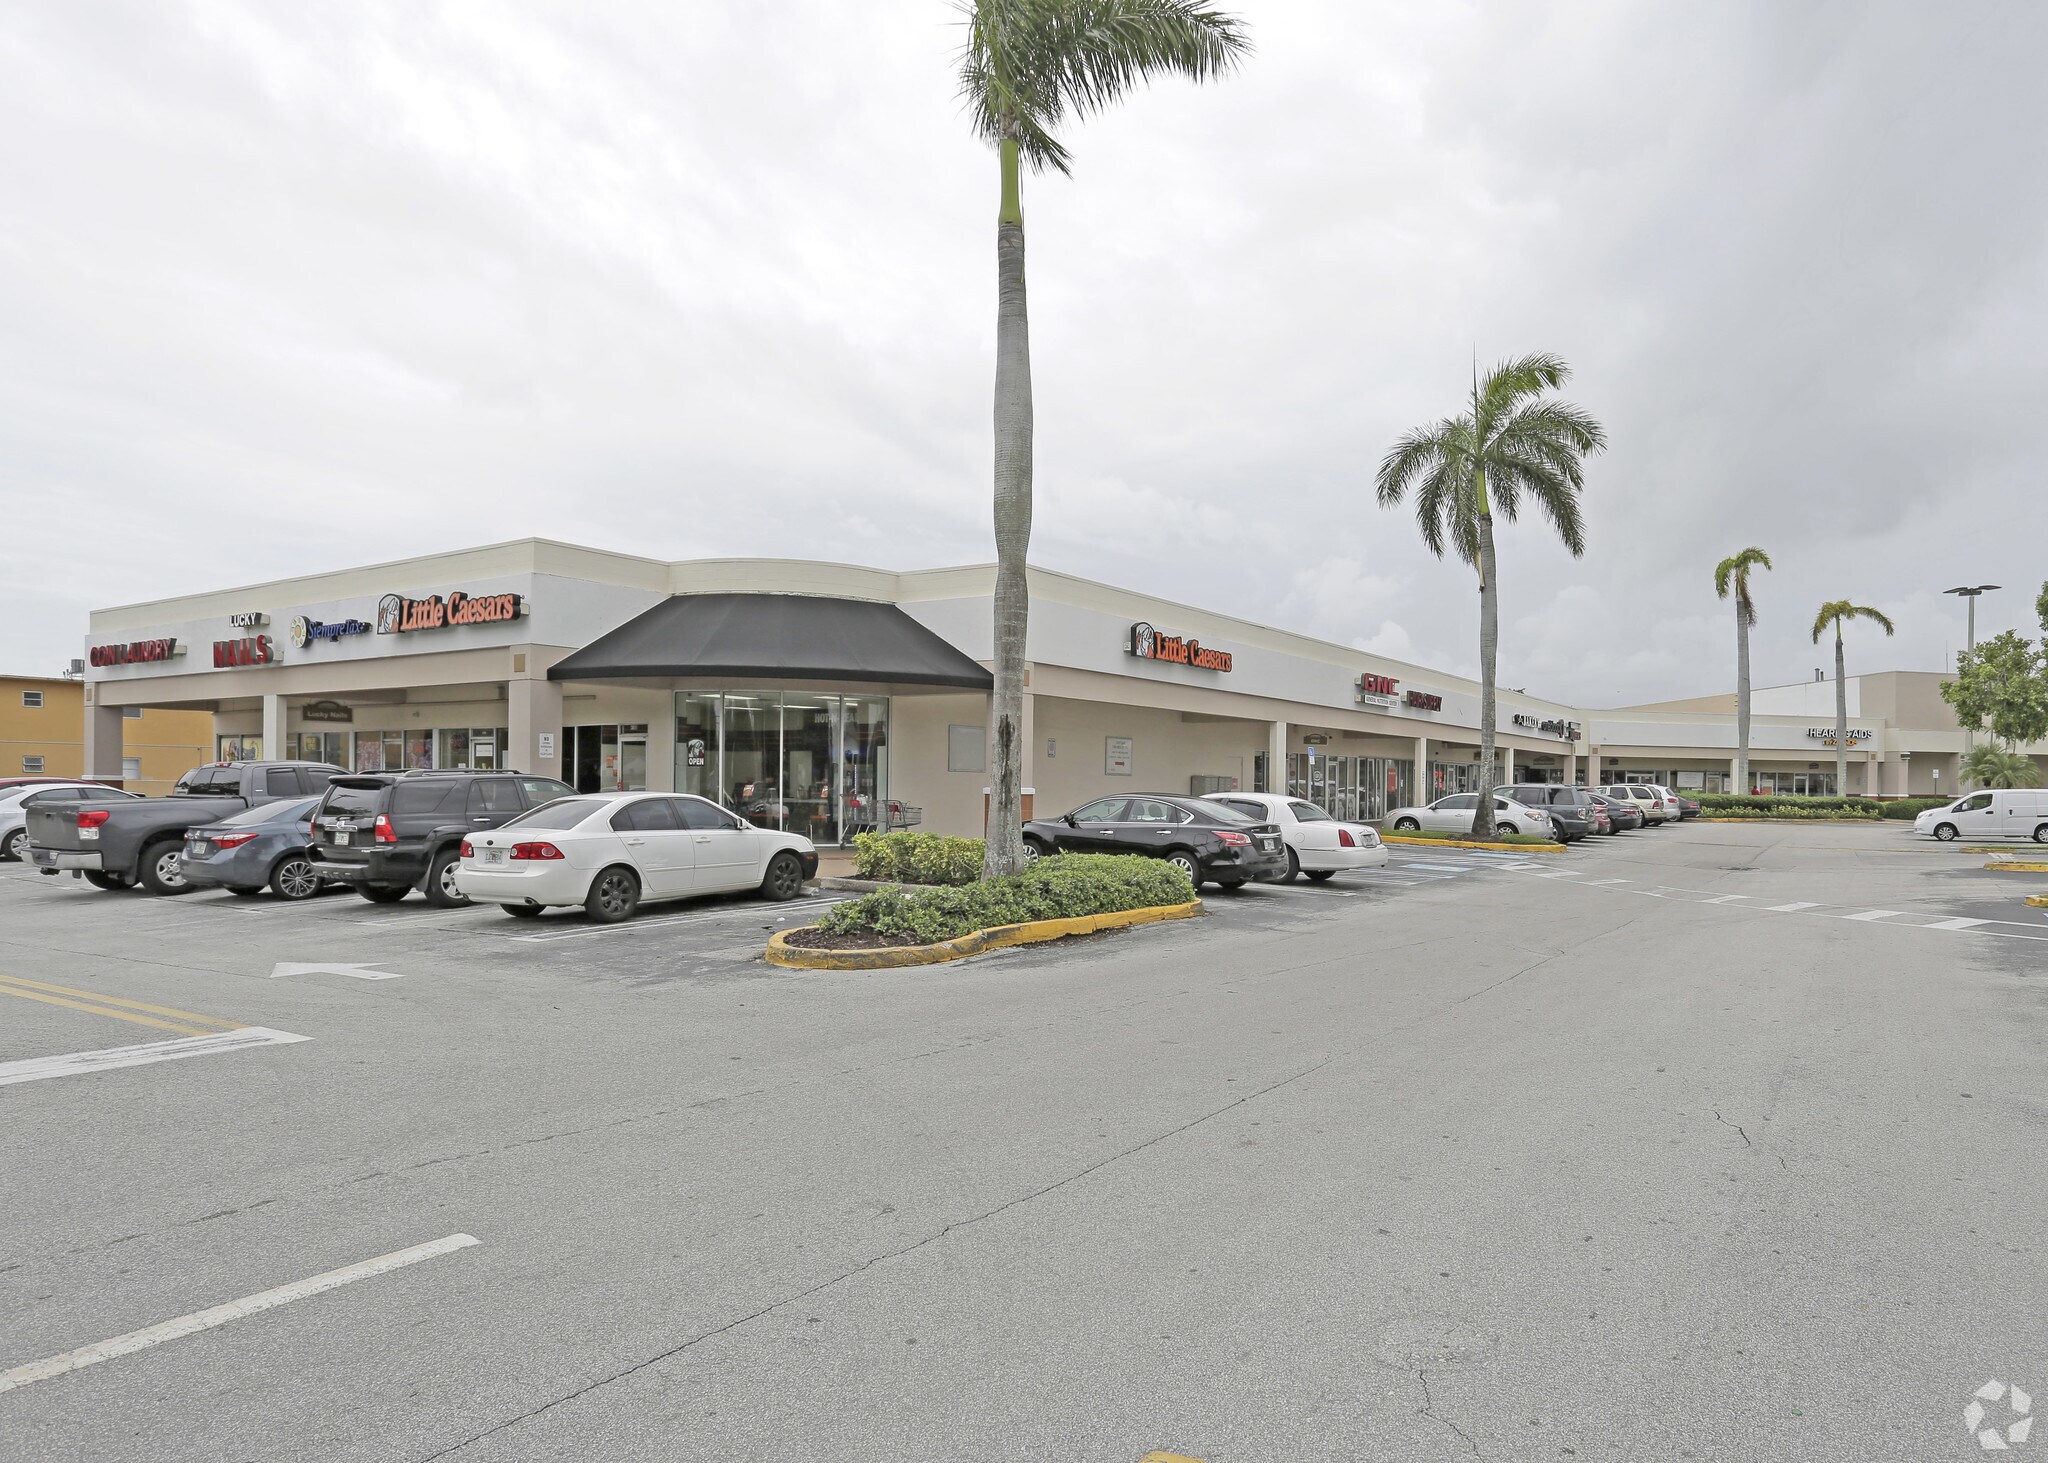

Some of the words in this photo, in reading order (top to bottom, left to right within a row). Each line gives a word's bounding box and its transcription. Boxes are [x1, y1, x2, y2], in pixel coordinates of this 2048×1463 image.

[229, 612, 257, 627] LUCKY
[400, 595, 443, 630] Little
[447, 592, 514, 625] Caesars
[90, 645, 117, 667] COIN
[119, 638, 173, 664] LAUNDRY
[213, 634, 270, 668] NAILS
[1154, 632, 1188, 664] Little
[1190, 639, 1232, 672] Caesars
[1362, 673, 1400, 696] GNC
[1852, 729, 1873, 739] AIDS
[688, 757, 705, 766] OPEN
